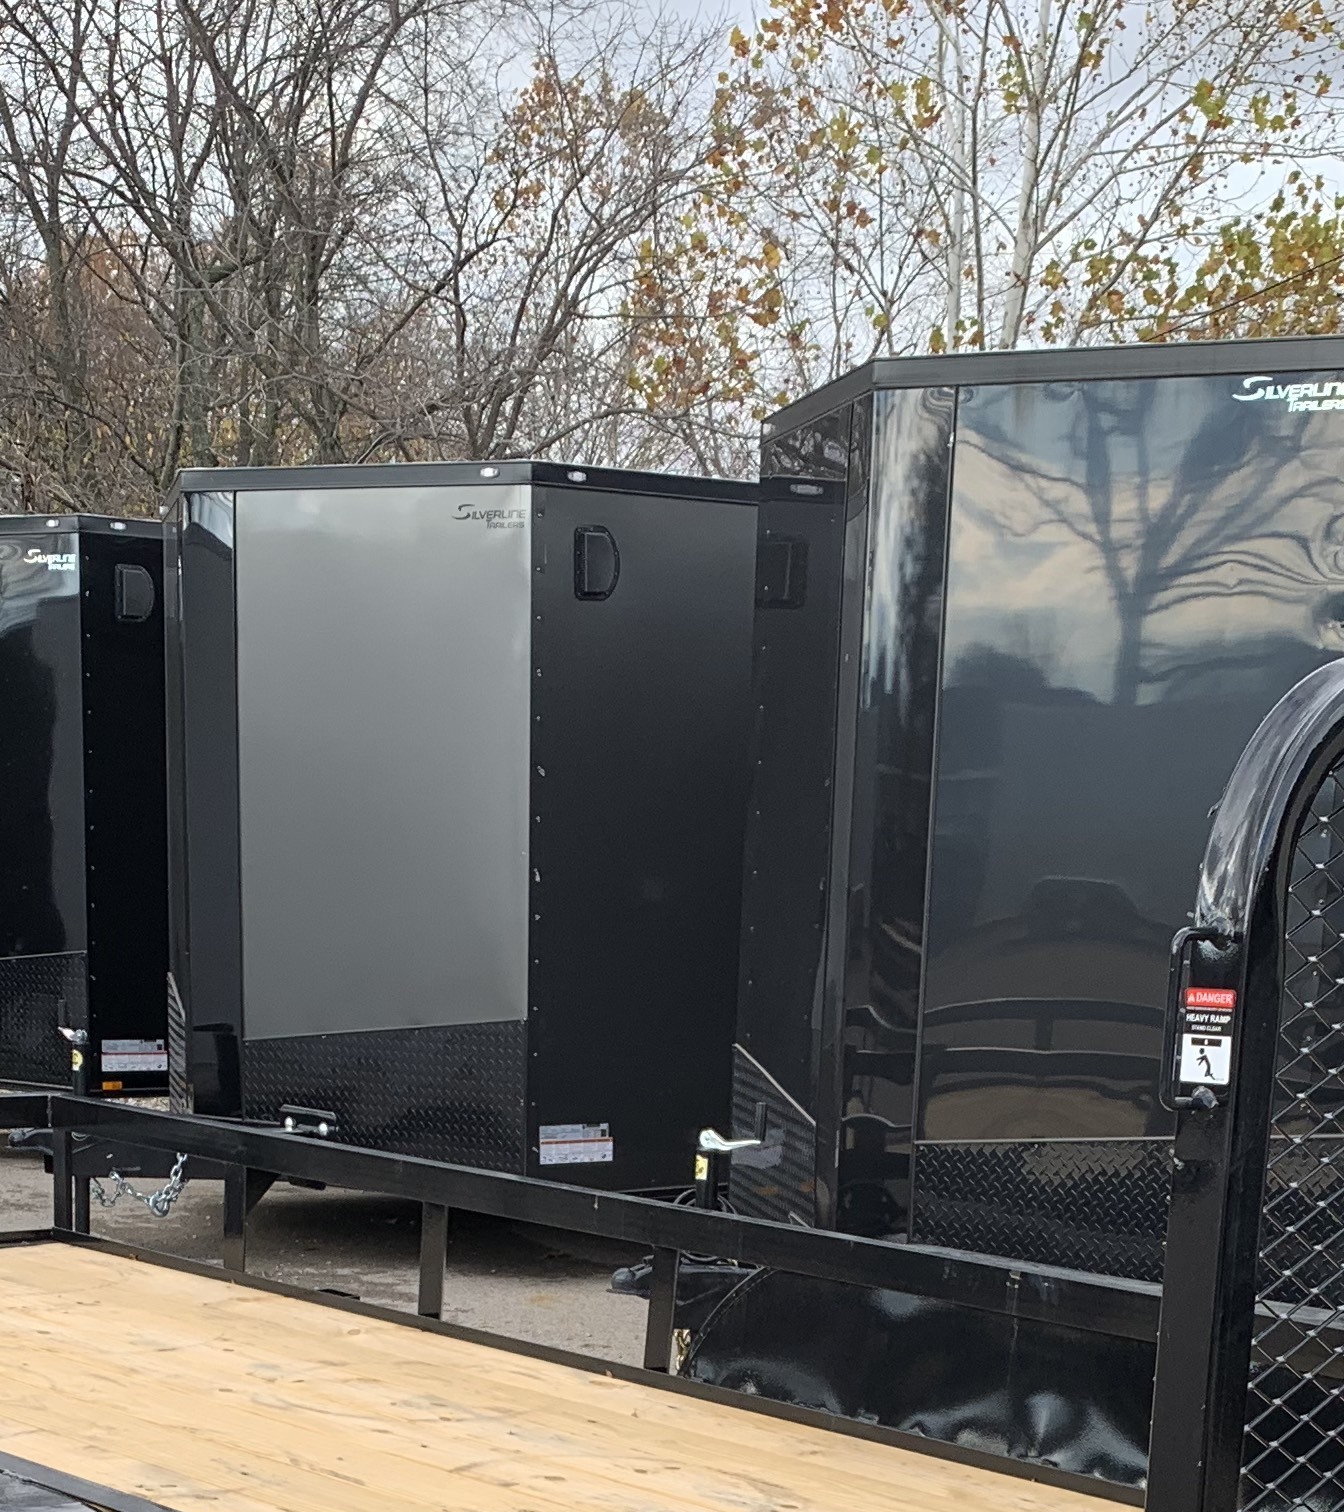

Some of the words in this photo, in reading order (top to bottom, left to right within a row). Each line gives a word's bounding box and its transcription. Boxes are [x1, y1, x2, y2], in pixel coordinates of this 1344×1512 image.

[1196, 992, 1233, 1005] DANGER
[1186, 1013, 1209, 1023] HEAVY
[1210, 1015, 1232, 1024] RAMP
